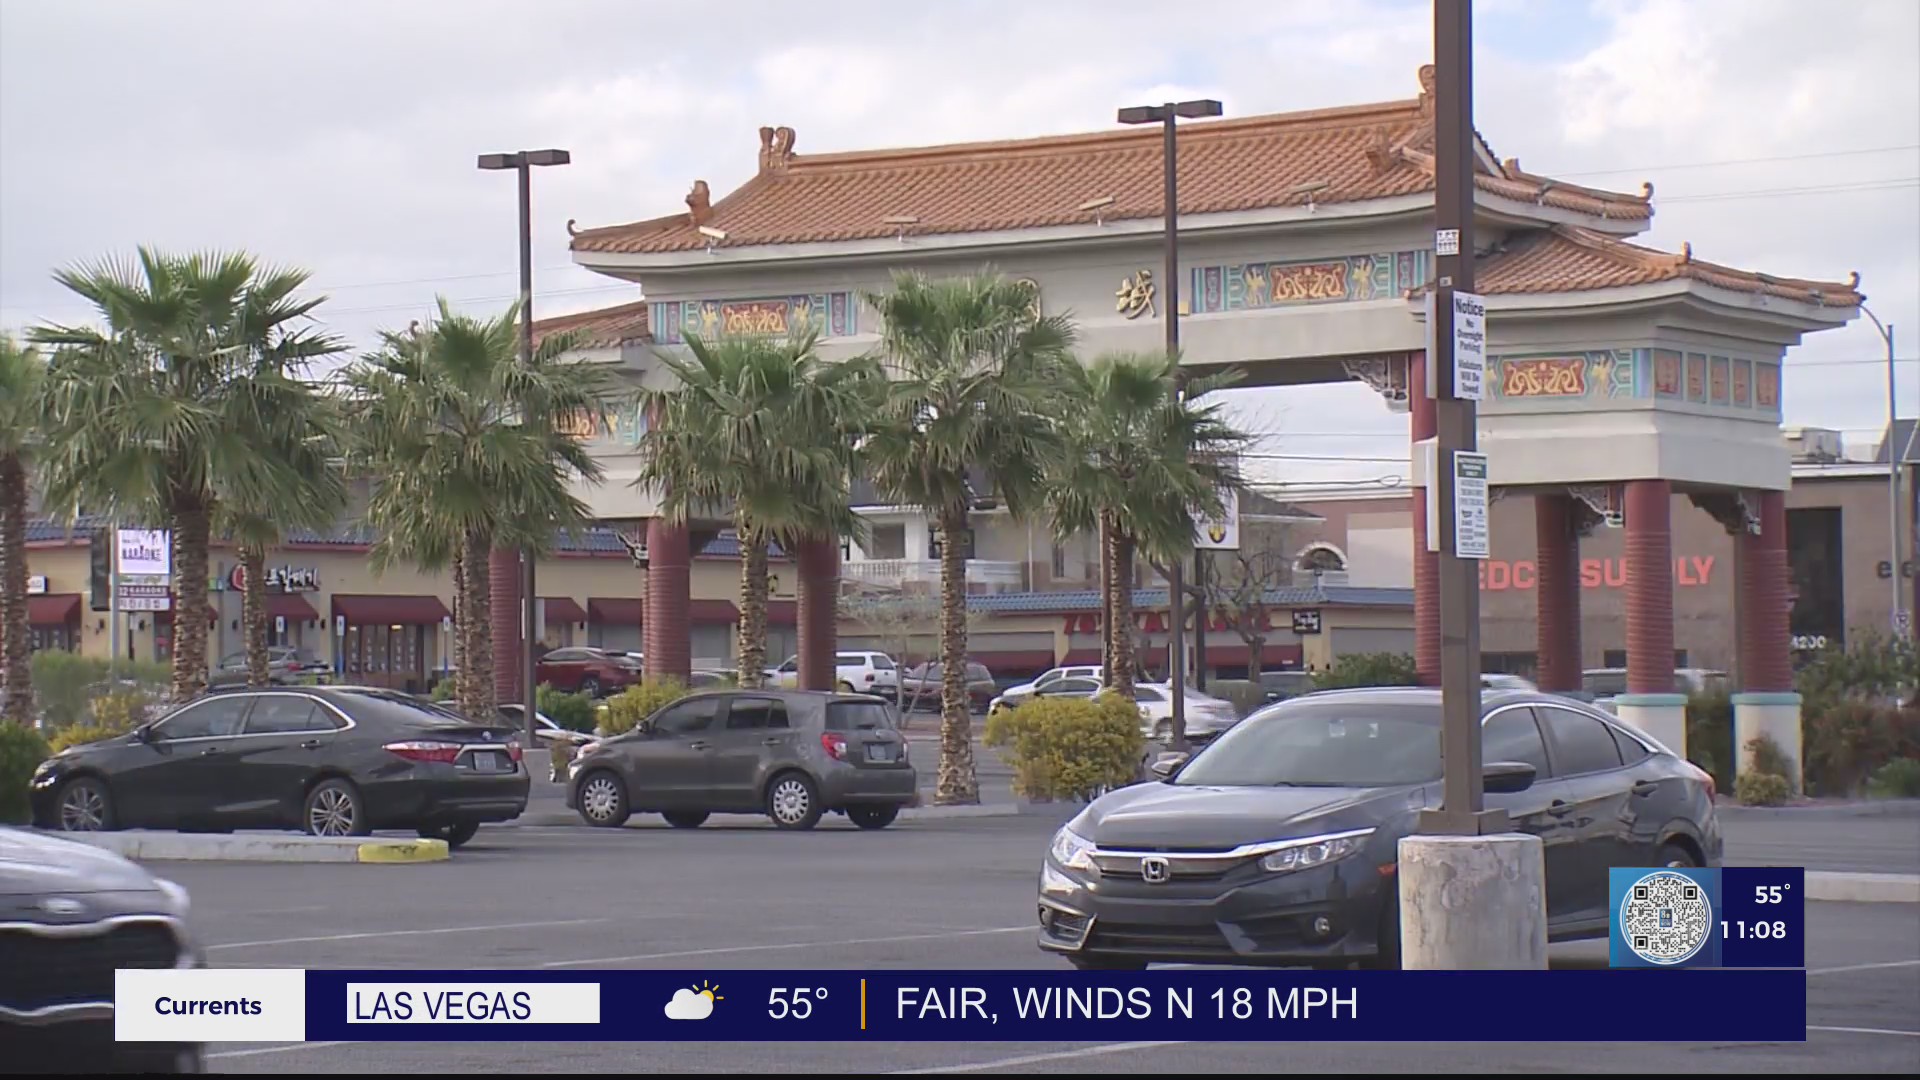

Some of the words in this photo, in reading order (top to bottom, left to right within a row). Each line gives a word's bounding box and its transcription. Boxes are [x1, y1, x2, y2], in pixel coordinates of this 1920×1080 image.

[1455, 298, 1484, 316] Notice
[1465, 318, 1474, 328] No
[1457, 328, 1483, 342] Overnight
[1460, 340, 1481, 355] Parking
[1458, 359, 1483, 371] Violators
[1460, 371, 1471, 381] Will
[1472, 372, 1480, 382] Be
[1462, 382, 1479, 393] Towed
[122, 545, 163, 561] KARAOKE
[265, 564, 318, 592] 포갈매기
[1580, 556, 1714, 588] SULY
